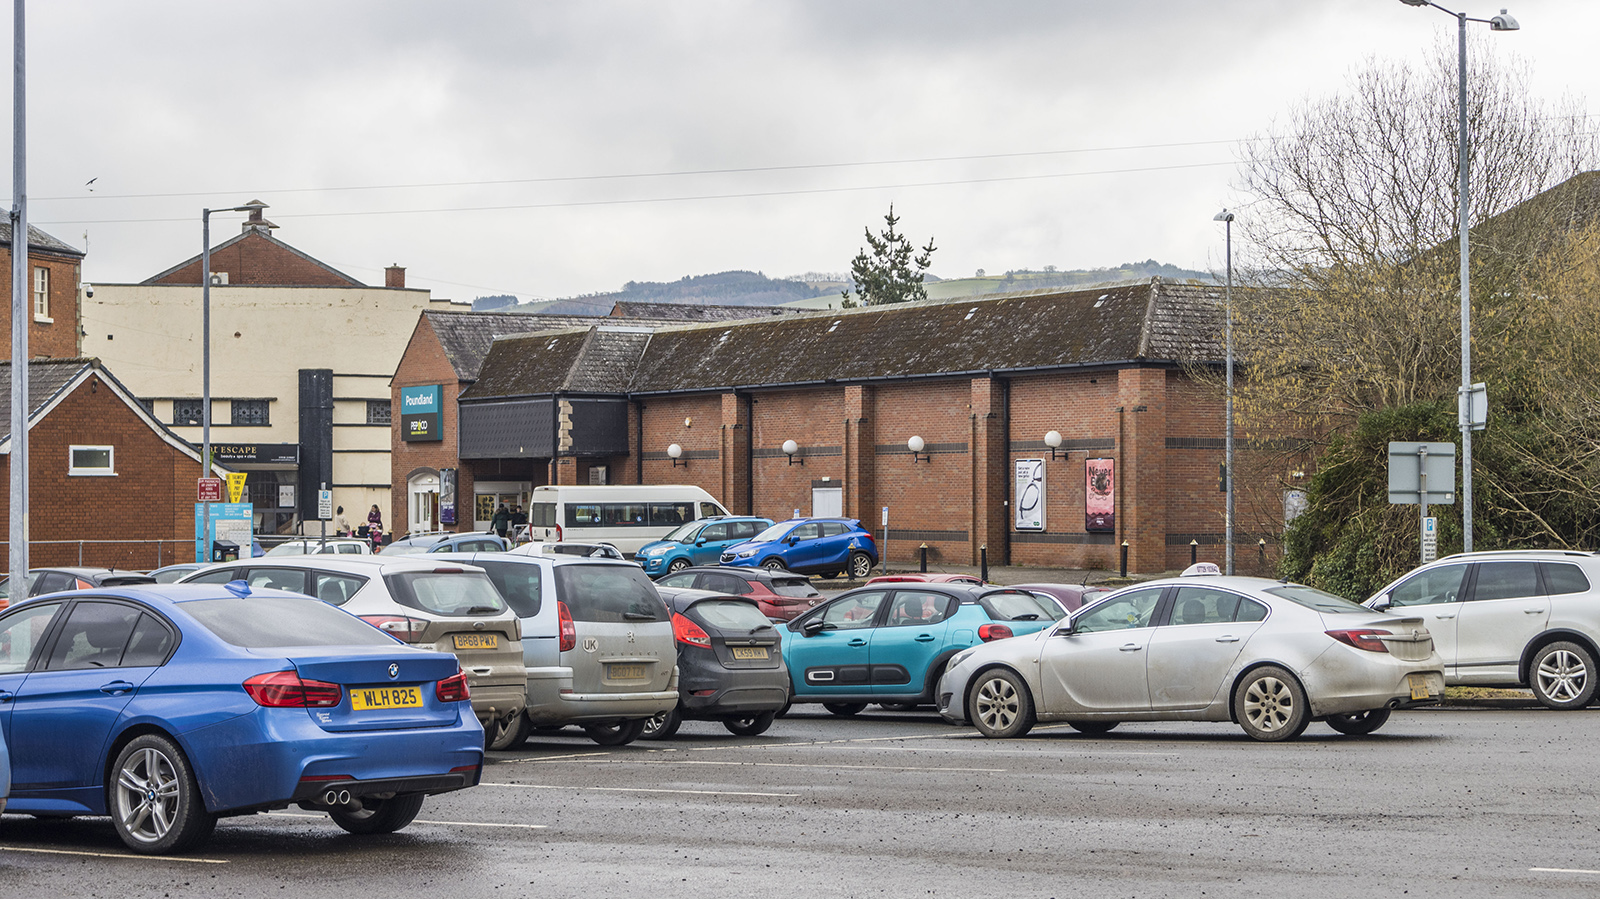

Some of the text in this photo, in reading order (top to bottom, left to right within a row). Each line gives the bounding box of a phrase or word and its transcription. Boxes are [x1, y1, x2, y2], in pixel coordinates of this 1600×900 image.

[406, 393, 432, 406] Poundland
[1088, 466, 1111, 476] Never
[458, 636, 496, 646] BP68 PWX
[584, 640, 596, 650] UK
[736, 648, 753, 658] CK59
[364, 689, 416, 706] WLH 825
